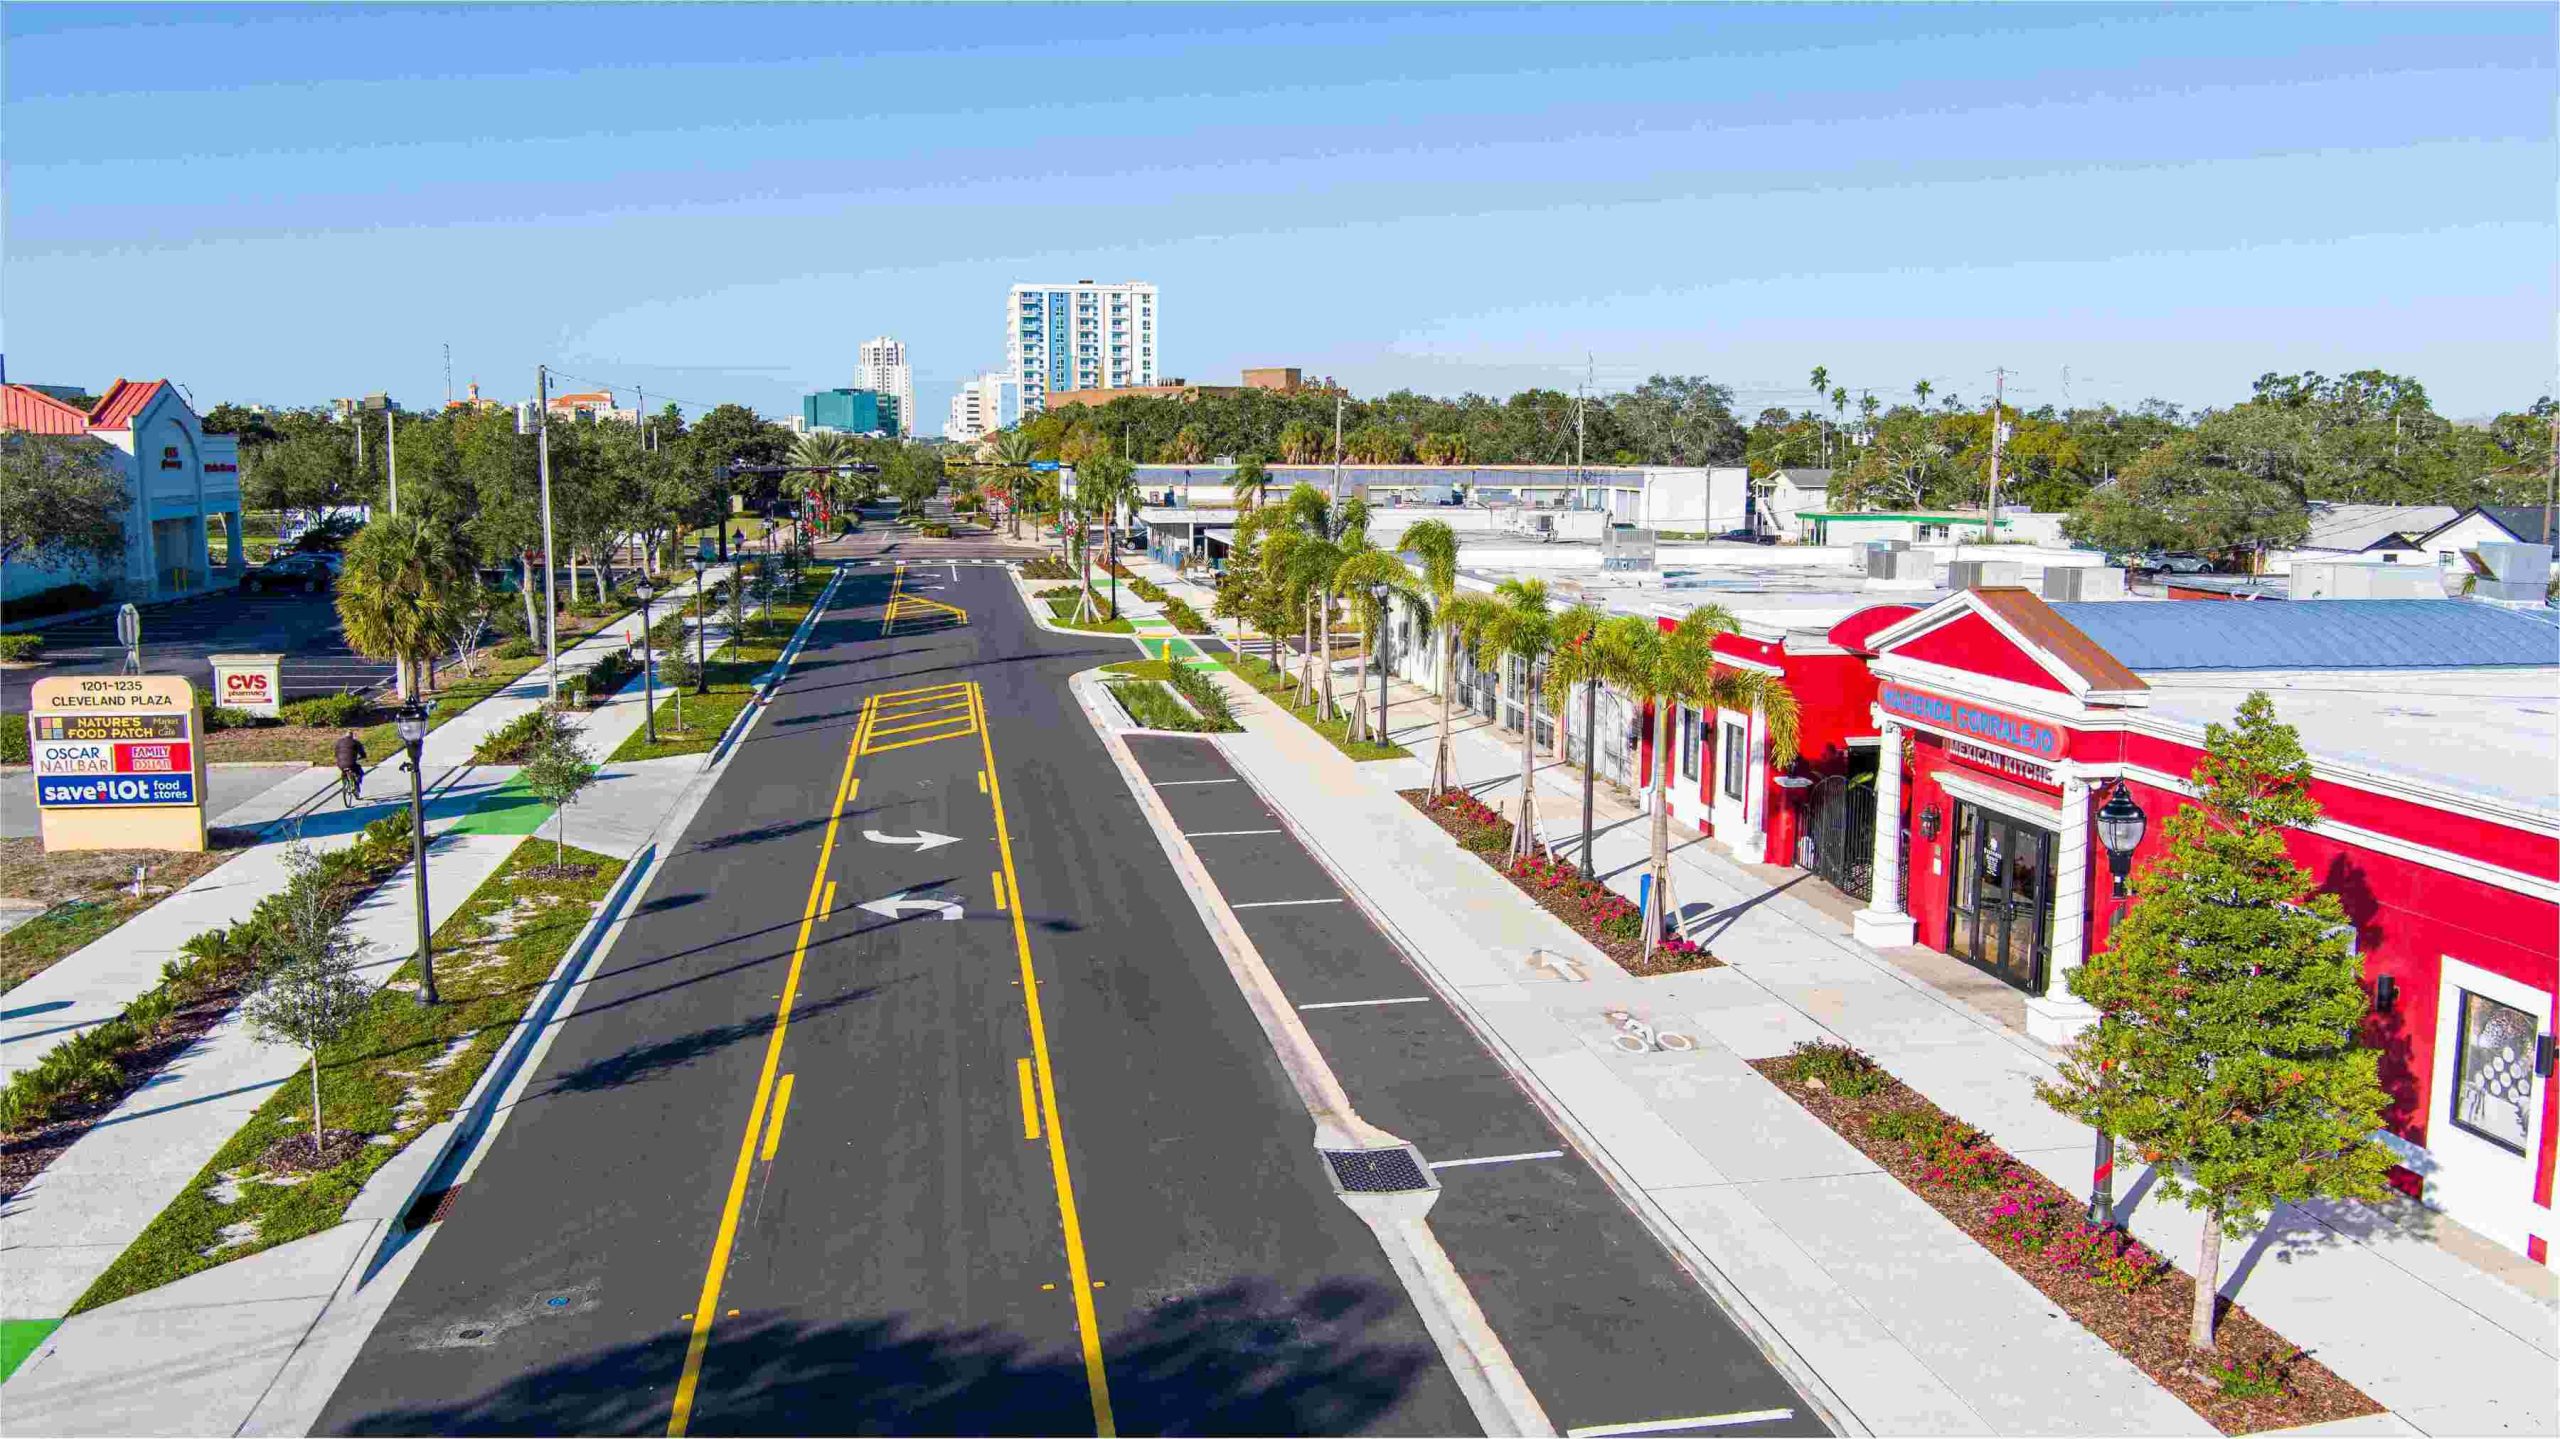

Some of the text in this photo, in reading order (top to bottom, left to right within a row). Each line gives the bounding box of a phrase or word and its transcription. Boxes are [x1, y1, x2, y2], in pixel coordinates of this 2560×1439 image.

[81, 680, 143, 691] 1201-1235
[227, 674, 268, 690] CVS
[51, 695, 173, 707] CLEVELAND PLAZA
[77, 717, 142, 728] NATURE'S
[67, 728, 154, 739] FOOD PATCH
[45, 747, 100, 760] OSCAR
[132, 746, 170, 757] FAMILY
[1949, 739, 2001, 770] MEXICAN
[153, 780, 180, 790] food
[153, 790, 188, 799] stores
